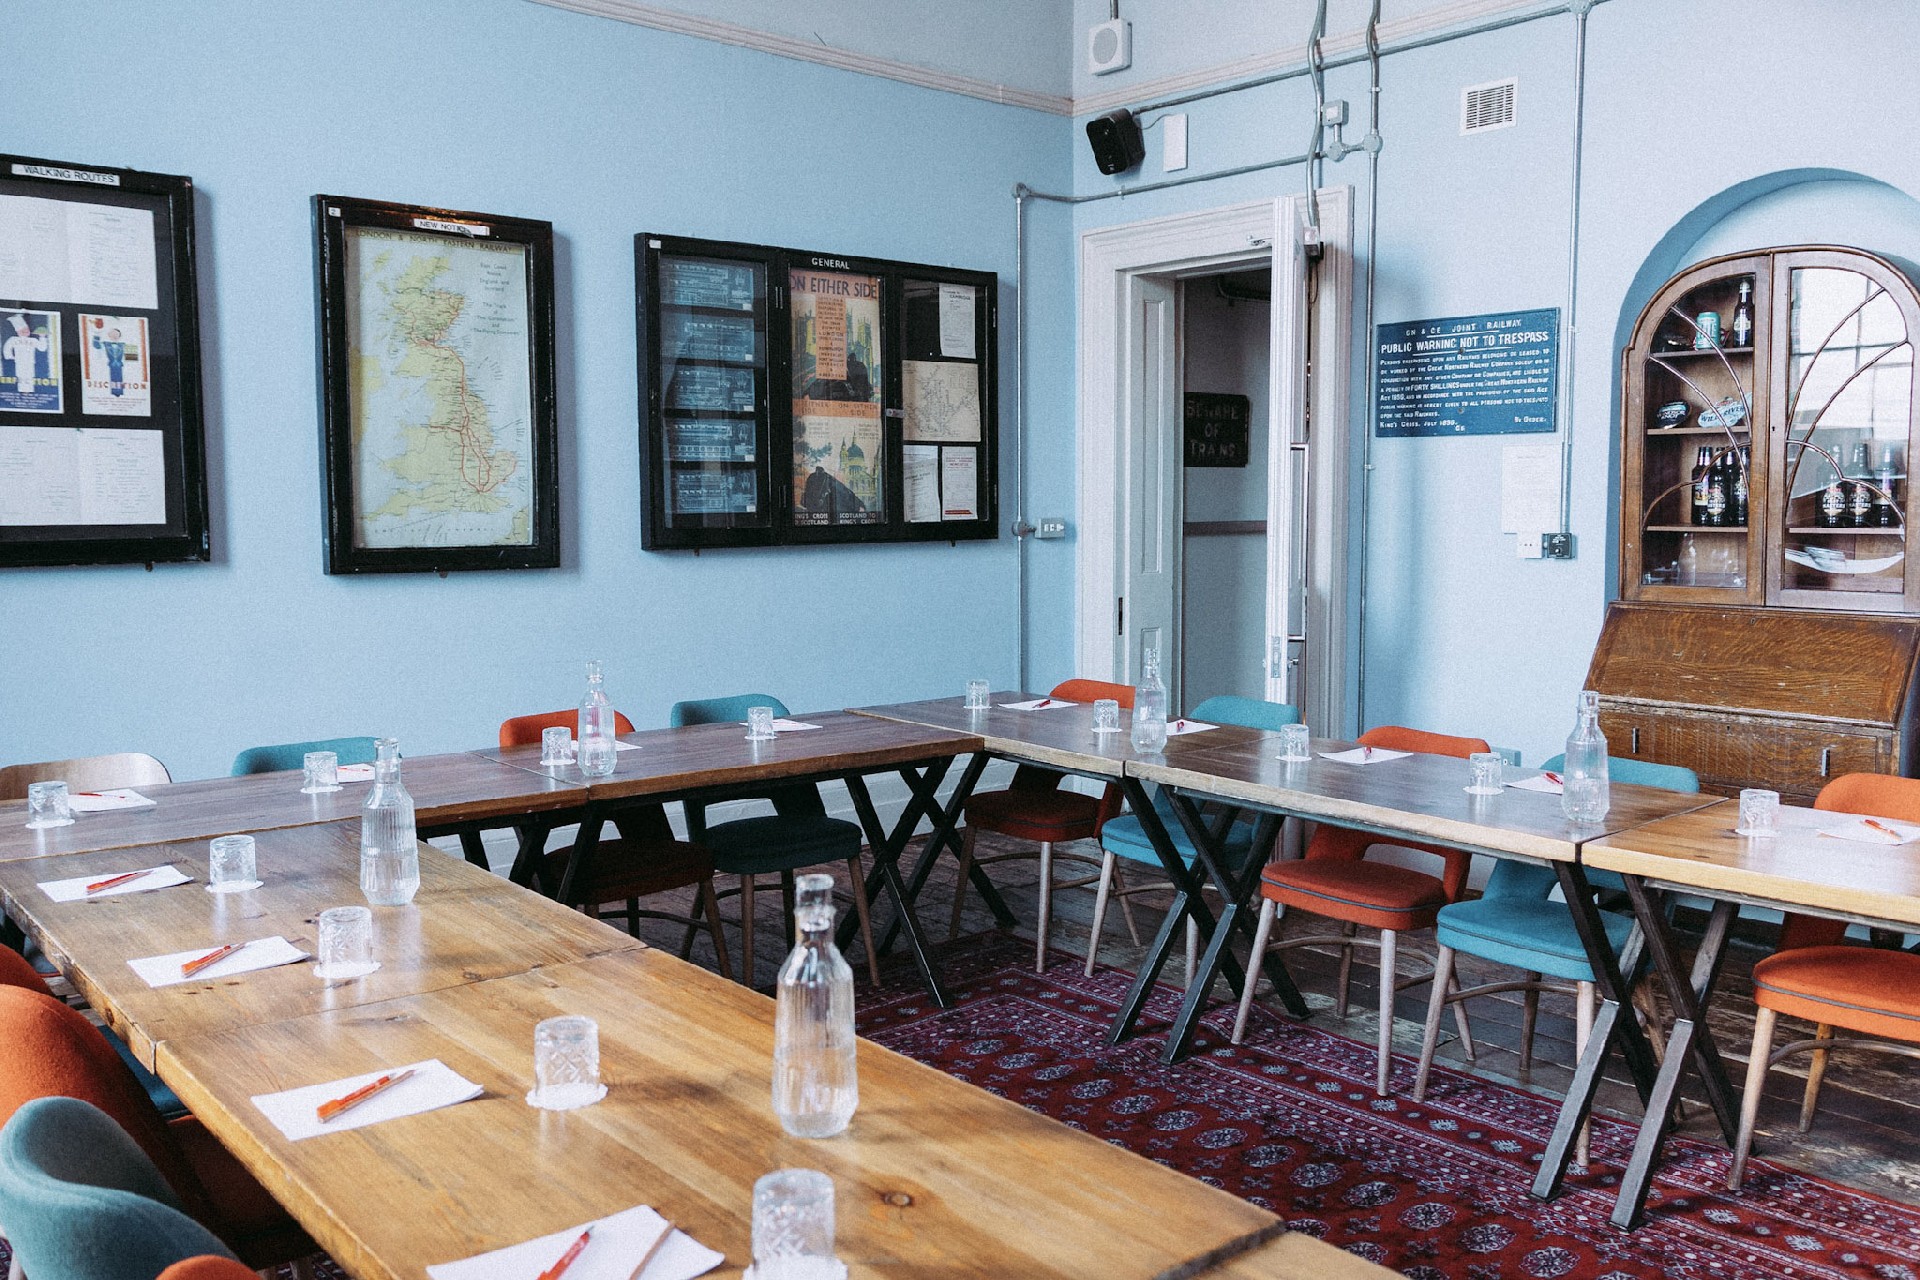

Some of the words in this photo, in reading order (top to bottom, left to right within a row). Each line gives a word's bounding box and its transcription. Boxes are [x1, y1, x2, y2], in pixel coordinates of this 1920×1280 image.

[24, 166, 70, 179] WALKING
[74, 172, 114, 183] ROUTES
[420, 221, 437, 229] NEW
[441, 224, 472, 236] NOTIC
[358, 230, 391, 240] LONDON
[410, 236, 437, 244] NORTH
[443, 238, 475, 248] EASTERN
[479, 242, 512, 253] RAILWAY
[811, 257, 850, 270] GENERAL
[810, 277, 851, 296] EITHER
[854, 282, 877, 299] SIDE
[1452, 323, 1475, 332] JOINT
[1381, 341, 1411, 354] PUBLIC
[1416, 338, 1456, 350] WARNING
[1460, 336, 1478, 347] NOT
[1482, 334, 1494, 345] TO
[1498, 330, 1548, 344] TRESPASS
[1430, 381, 1459, 389] SHILLINGS
[1724, 406, 1744, 416] RIVER
